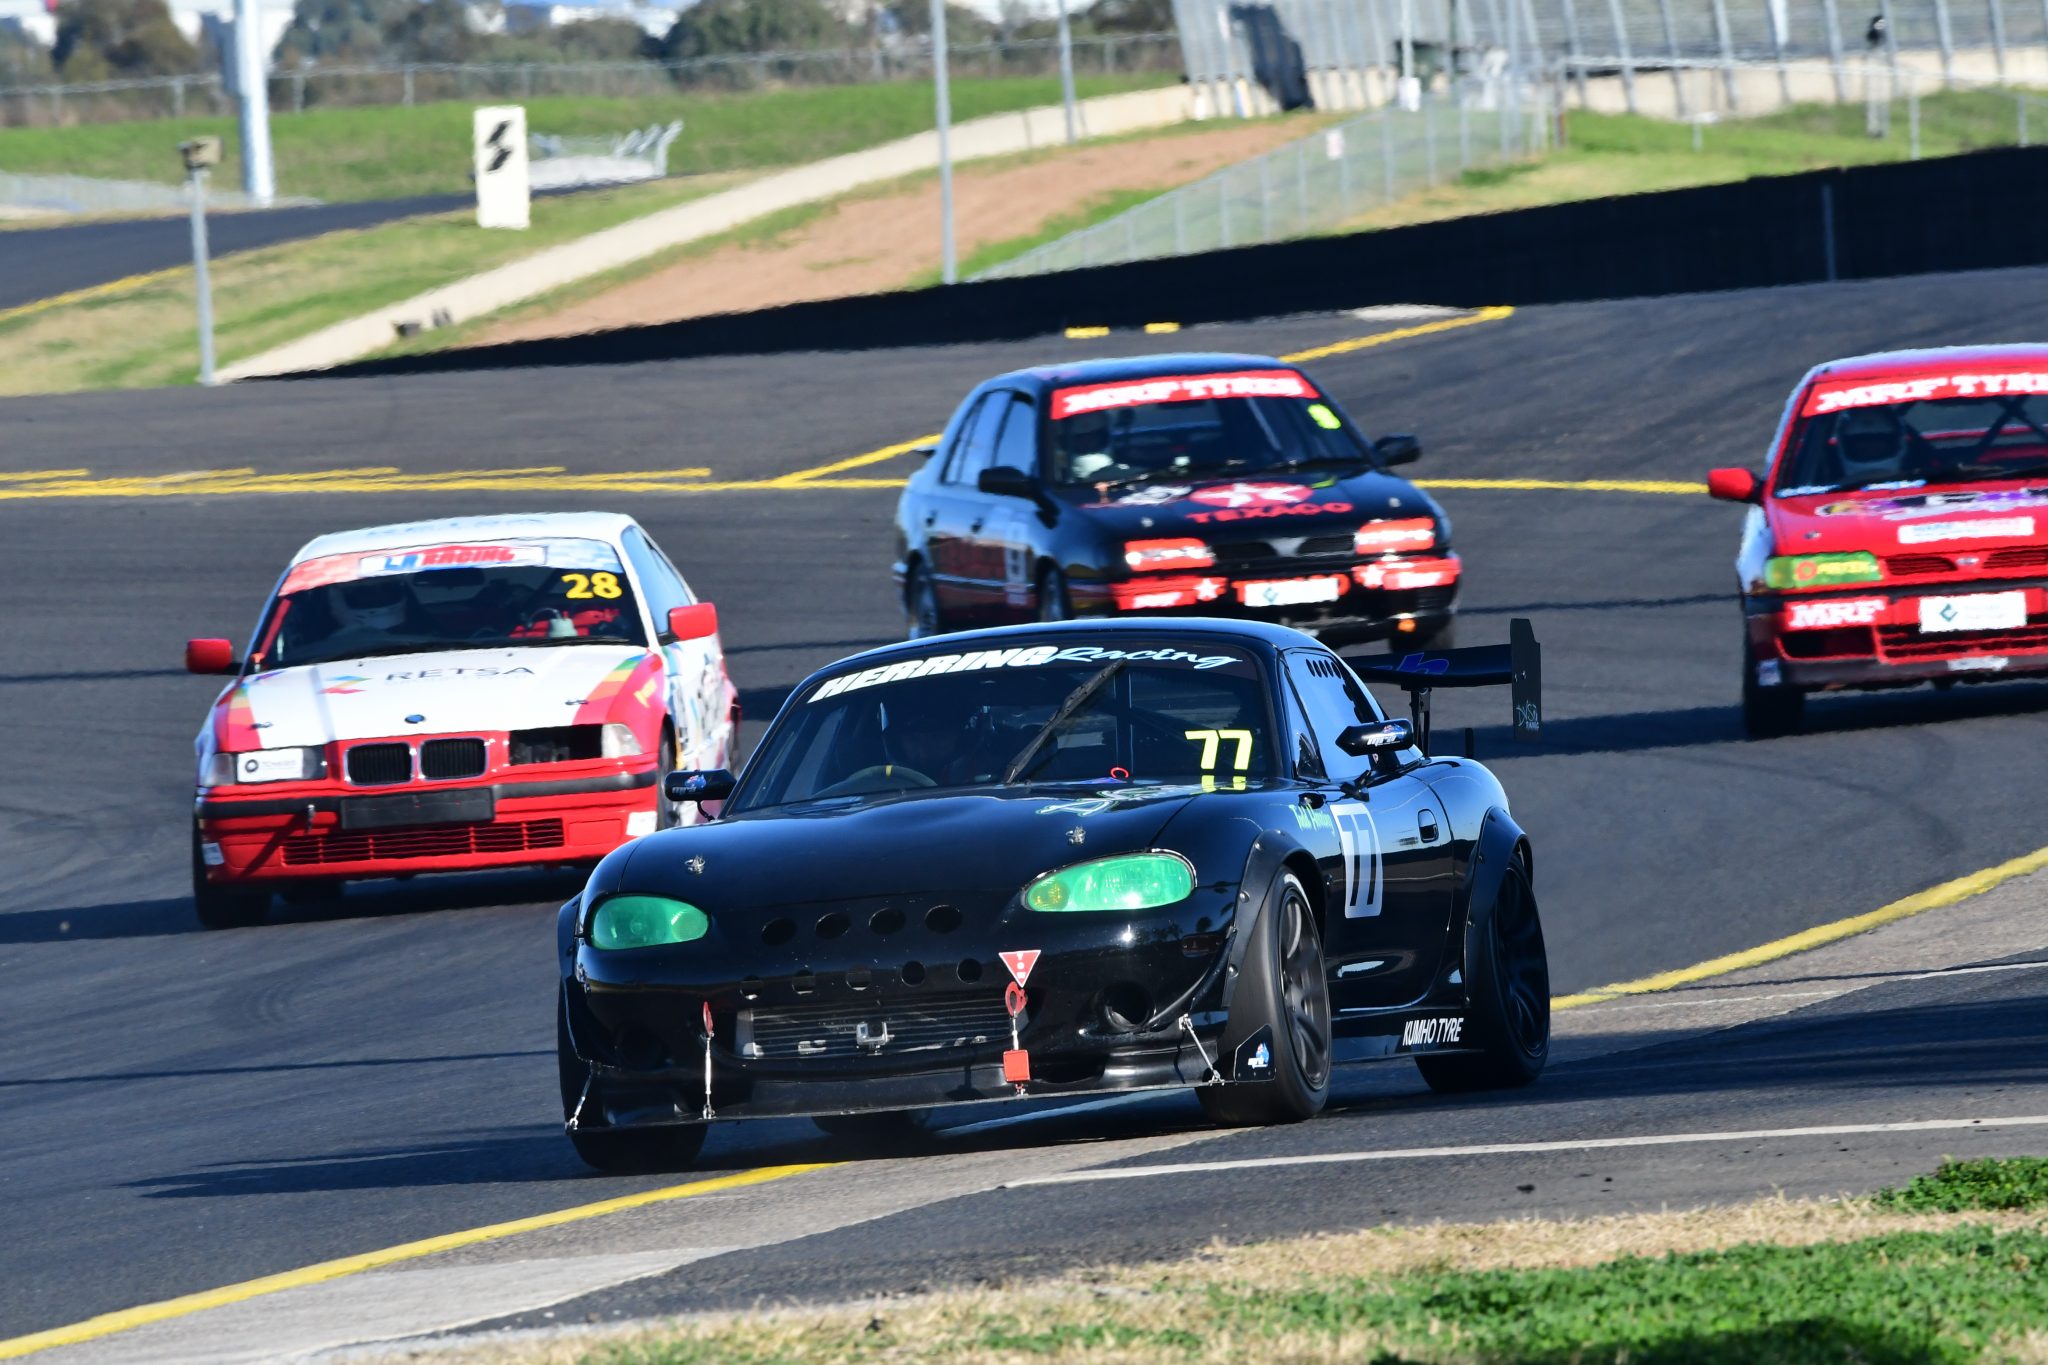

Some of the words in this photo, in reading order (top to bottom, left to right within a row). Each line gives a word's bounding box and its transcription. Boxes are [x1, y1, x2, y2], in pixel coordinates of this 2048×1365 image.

[1817, 377, 1949, 411] MRF
[1187, 502, 1354, 524] TEXACO
[562, 572, 623, 599] 28
[1789, 599, 1886, 628] MRF
[386, 667, 536, 681] RETSA
[807, 646, 1058, 704] HERRING
[1049, 646, 1243, 669] Racing
[1184, 729, 1253, 770] 77
[1337, 813, 1377, 907] 77
[1402, 1018, 1437, 1046] KUMHO
[1436, 1018, 1464, 1043] TYRE
